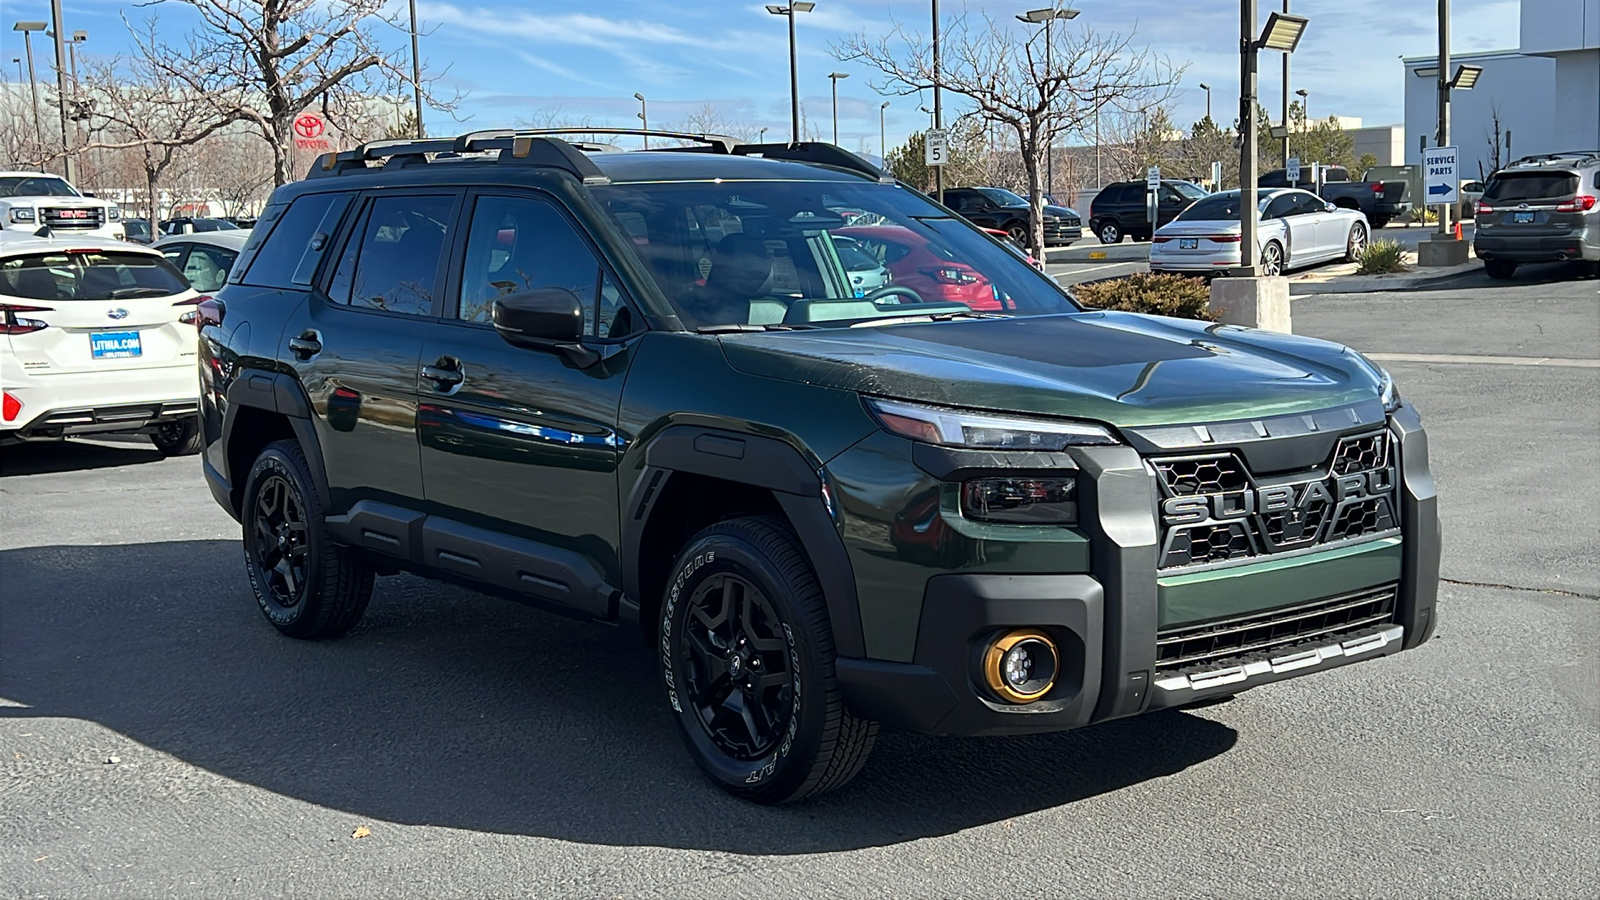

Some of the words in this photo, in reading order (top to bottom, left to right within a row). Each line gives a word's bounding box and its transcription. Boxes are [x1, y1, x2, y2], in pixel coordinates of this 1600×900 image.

[933, 148, 941, 161] 5
[1426, 156, 1455, 165] SERVICE
[1430, 167, 1452, 175] PARTS
[60, 210, 87, 218] GMC
[92, 338, 139, 351] LITHIA.COM
[1162, 467, 1394, 524] SUBARU
